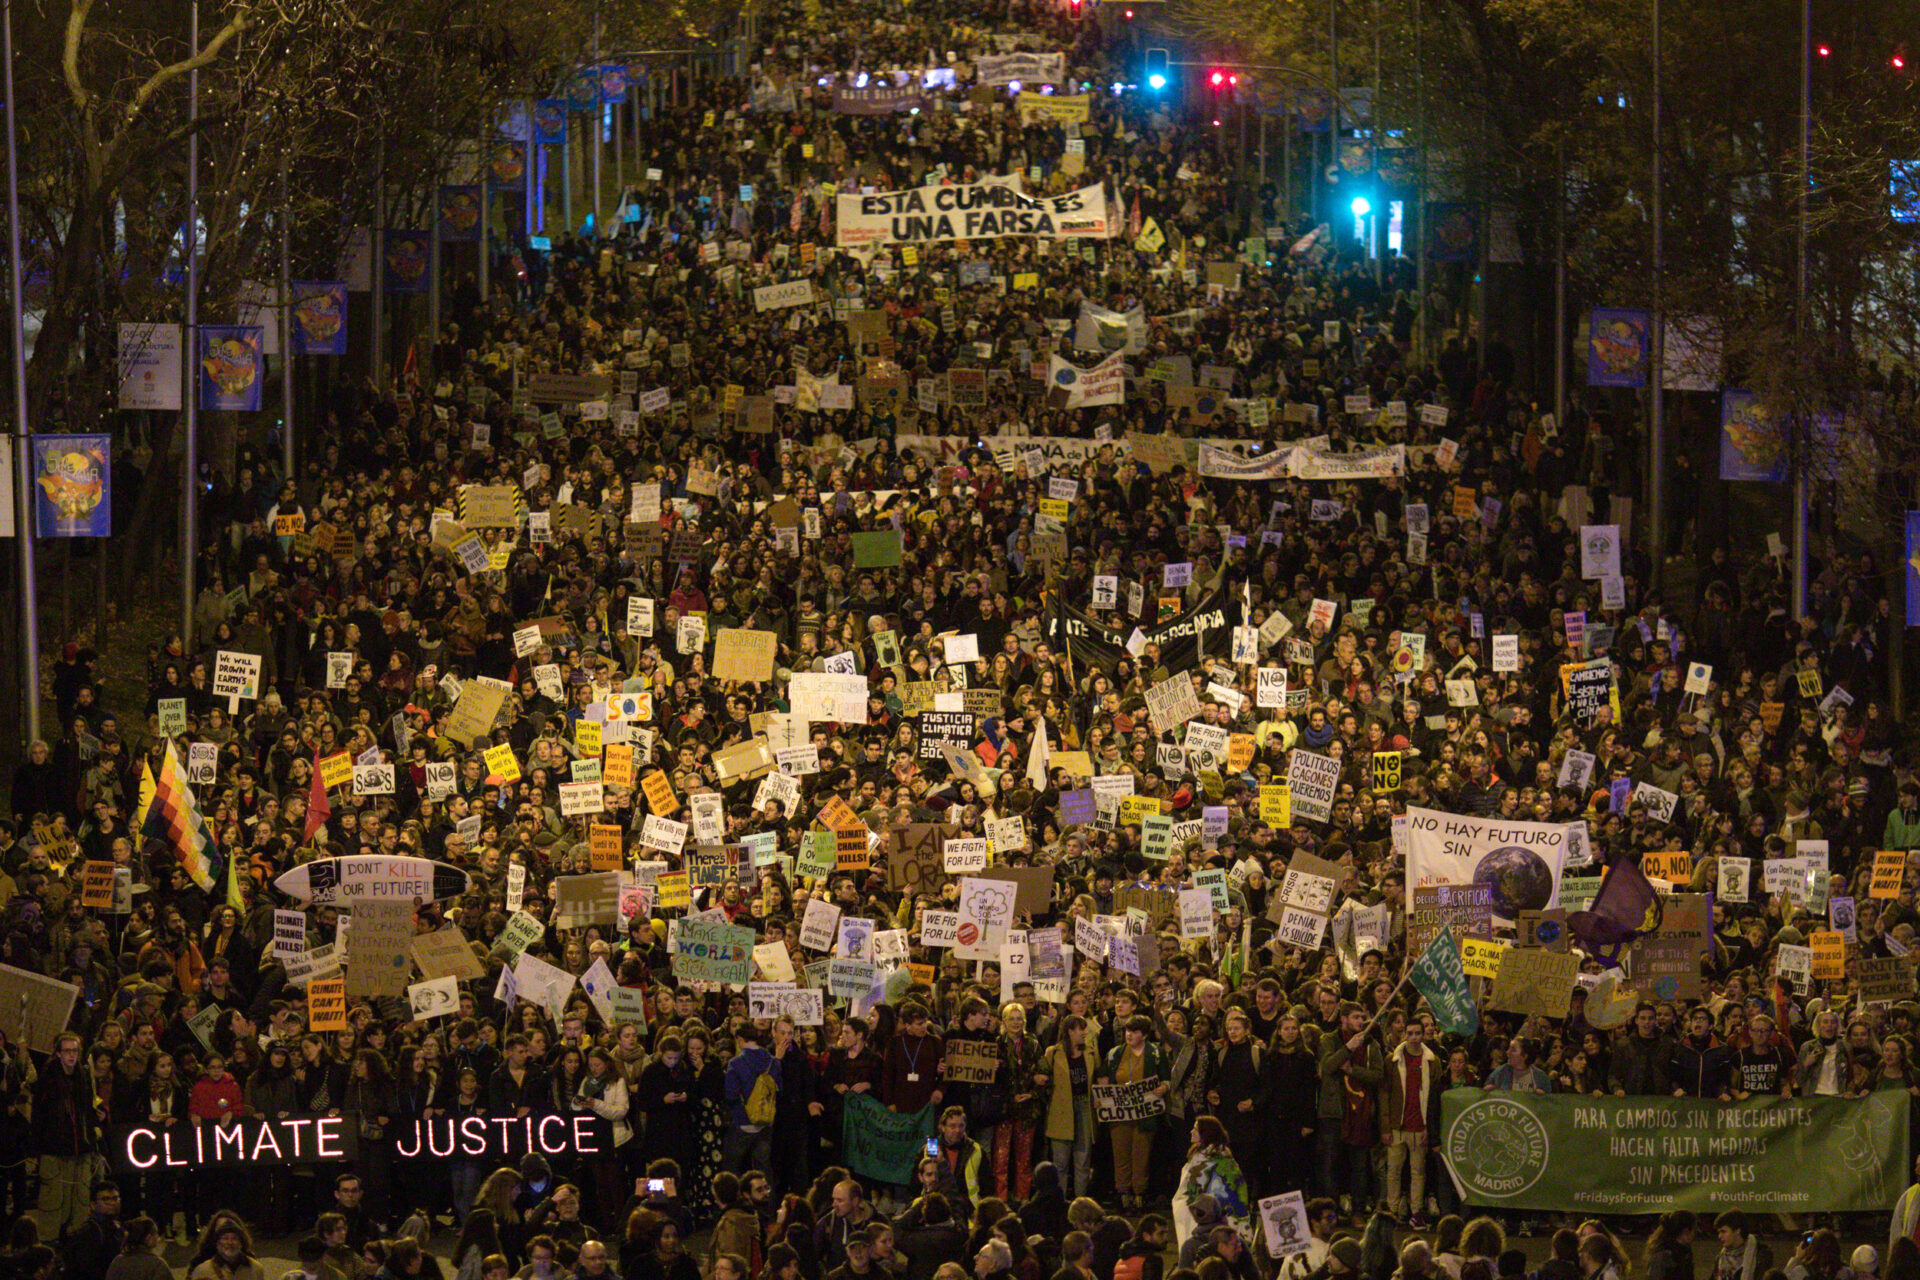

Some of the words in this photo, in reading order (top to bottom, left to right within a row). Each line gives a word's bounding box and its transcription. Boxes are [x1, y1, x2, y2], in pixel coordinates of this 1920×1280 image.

[862, 190, 926, 215] ESTA
[935, 185, 1046, 212] CUMBRE
[1054, 193, 1084, 214] ES
[892, 215, 956, 240] UNA
[965, 211, 1055, 236] FARSA
[922, 724, 972, 736] CLIMATICA
[1204, 728, 1225, 741] FIGTH
[920, 748, 943, 759] SOC
[1294, 751, 1340, 775] POLITICOS
[1291, 766, 1333, 788] CAGONES
[1287, 779, 1331, 801] QUEREMOS
[836, 829, 866, 839] CLIMATE
[1412, 817, 1438, 832] NO
[1445, 822, 1482, 839] HAY
[1488, 828, 1562, 846] FUTURO
[836, 841, 867, 851] CHANGE
[947, 842, 960, 852] WE
[1443, 840, 1472, 857] SIN
[686, 847, 725, 866] There's
[725, 846, 739, 865] NO
[946, 856, 961, 866] FOR
[388, 863, 423, 877] KILL
[689, 866, 729, 884] PLANET
[892, 861, 949, 890] LORA
[1670, 860, 1690, 876] NO!
[1280, 872, 1298, 903] CRISIS
[275, 916, 304, 928] CLIMATE
[1287, 913, 1316, 930] DENIAL
[275, 929, 304, 939] CHANGE
[681, 921, 716, 942] MAKE
[1290, 930, 1316, 945] SUICIDE
[678, 941, 746, 962] WORLD
[946, 1042, 998, 1058] SILENCE
[946, 1066, 993, 1082] OPTION
[1094, 1086, 1115, 1099] THE
[1115, 1077, 1161, 1097] EMPEROR
[1098, 1099, 1165, 1121] CLOTHES
[1573, 1108, 1608, 1129] PARA
[1615, 1109, 1678, 1129] CAMBIOS
[1685, 1109, 1709, 1129] SIN
[1716, 1107, 1812, 1129] PRECEDENTES
[125, 1116, 345, 1169] CLIMATE
[396, 1114, 600, 1157] JUSTICE
[1454, 1108, 1487, 1163] FRIDAYS
[1488, 1104, 1519, 1121] FOR
[1516, 1112, 1543, 1170] FUTURE
[1609, 1136, 1656, 1158] HACEN
[1662, 1136, 1700, 1157] FALTA
[1708, 1136, 1768, 1156] MEDIDAS
[1472, 1173, 1525, 1191] MADRID
[1627, 1165, 1654, 1185] SIN
[1659, 1163, 1756, 1184] PRECEDENTES
[1573, 1191, 1674, 1205] #FridaysForFuture
[1709, 1190, 1810, 1203] #YouthForClimate
